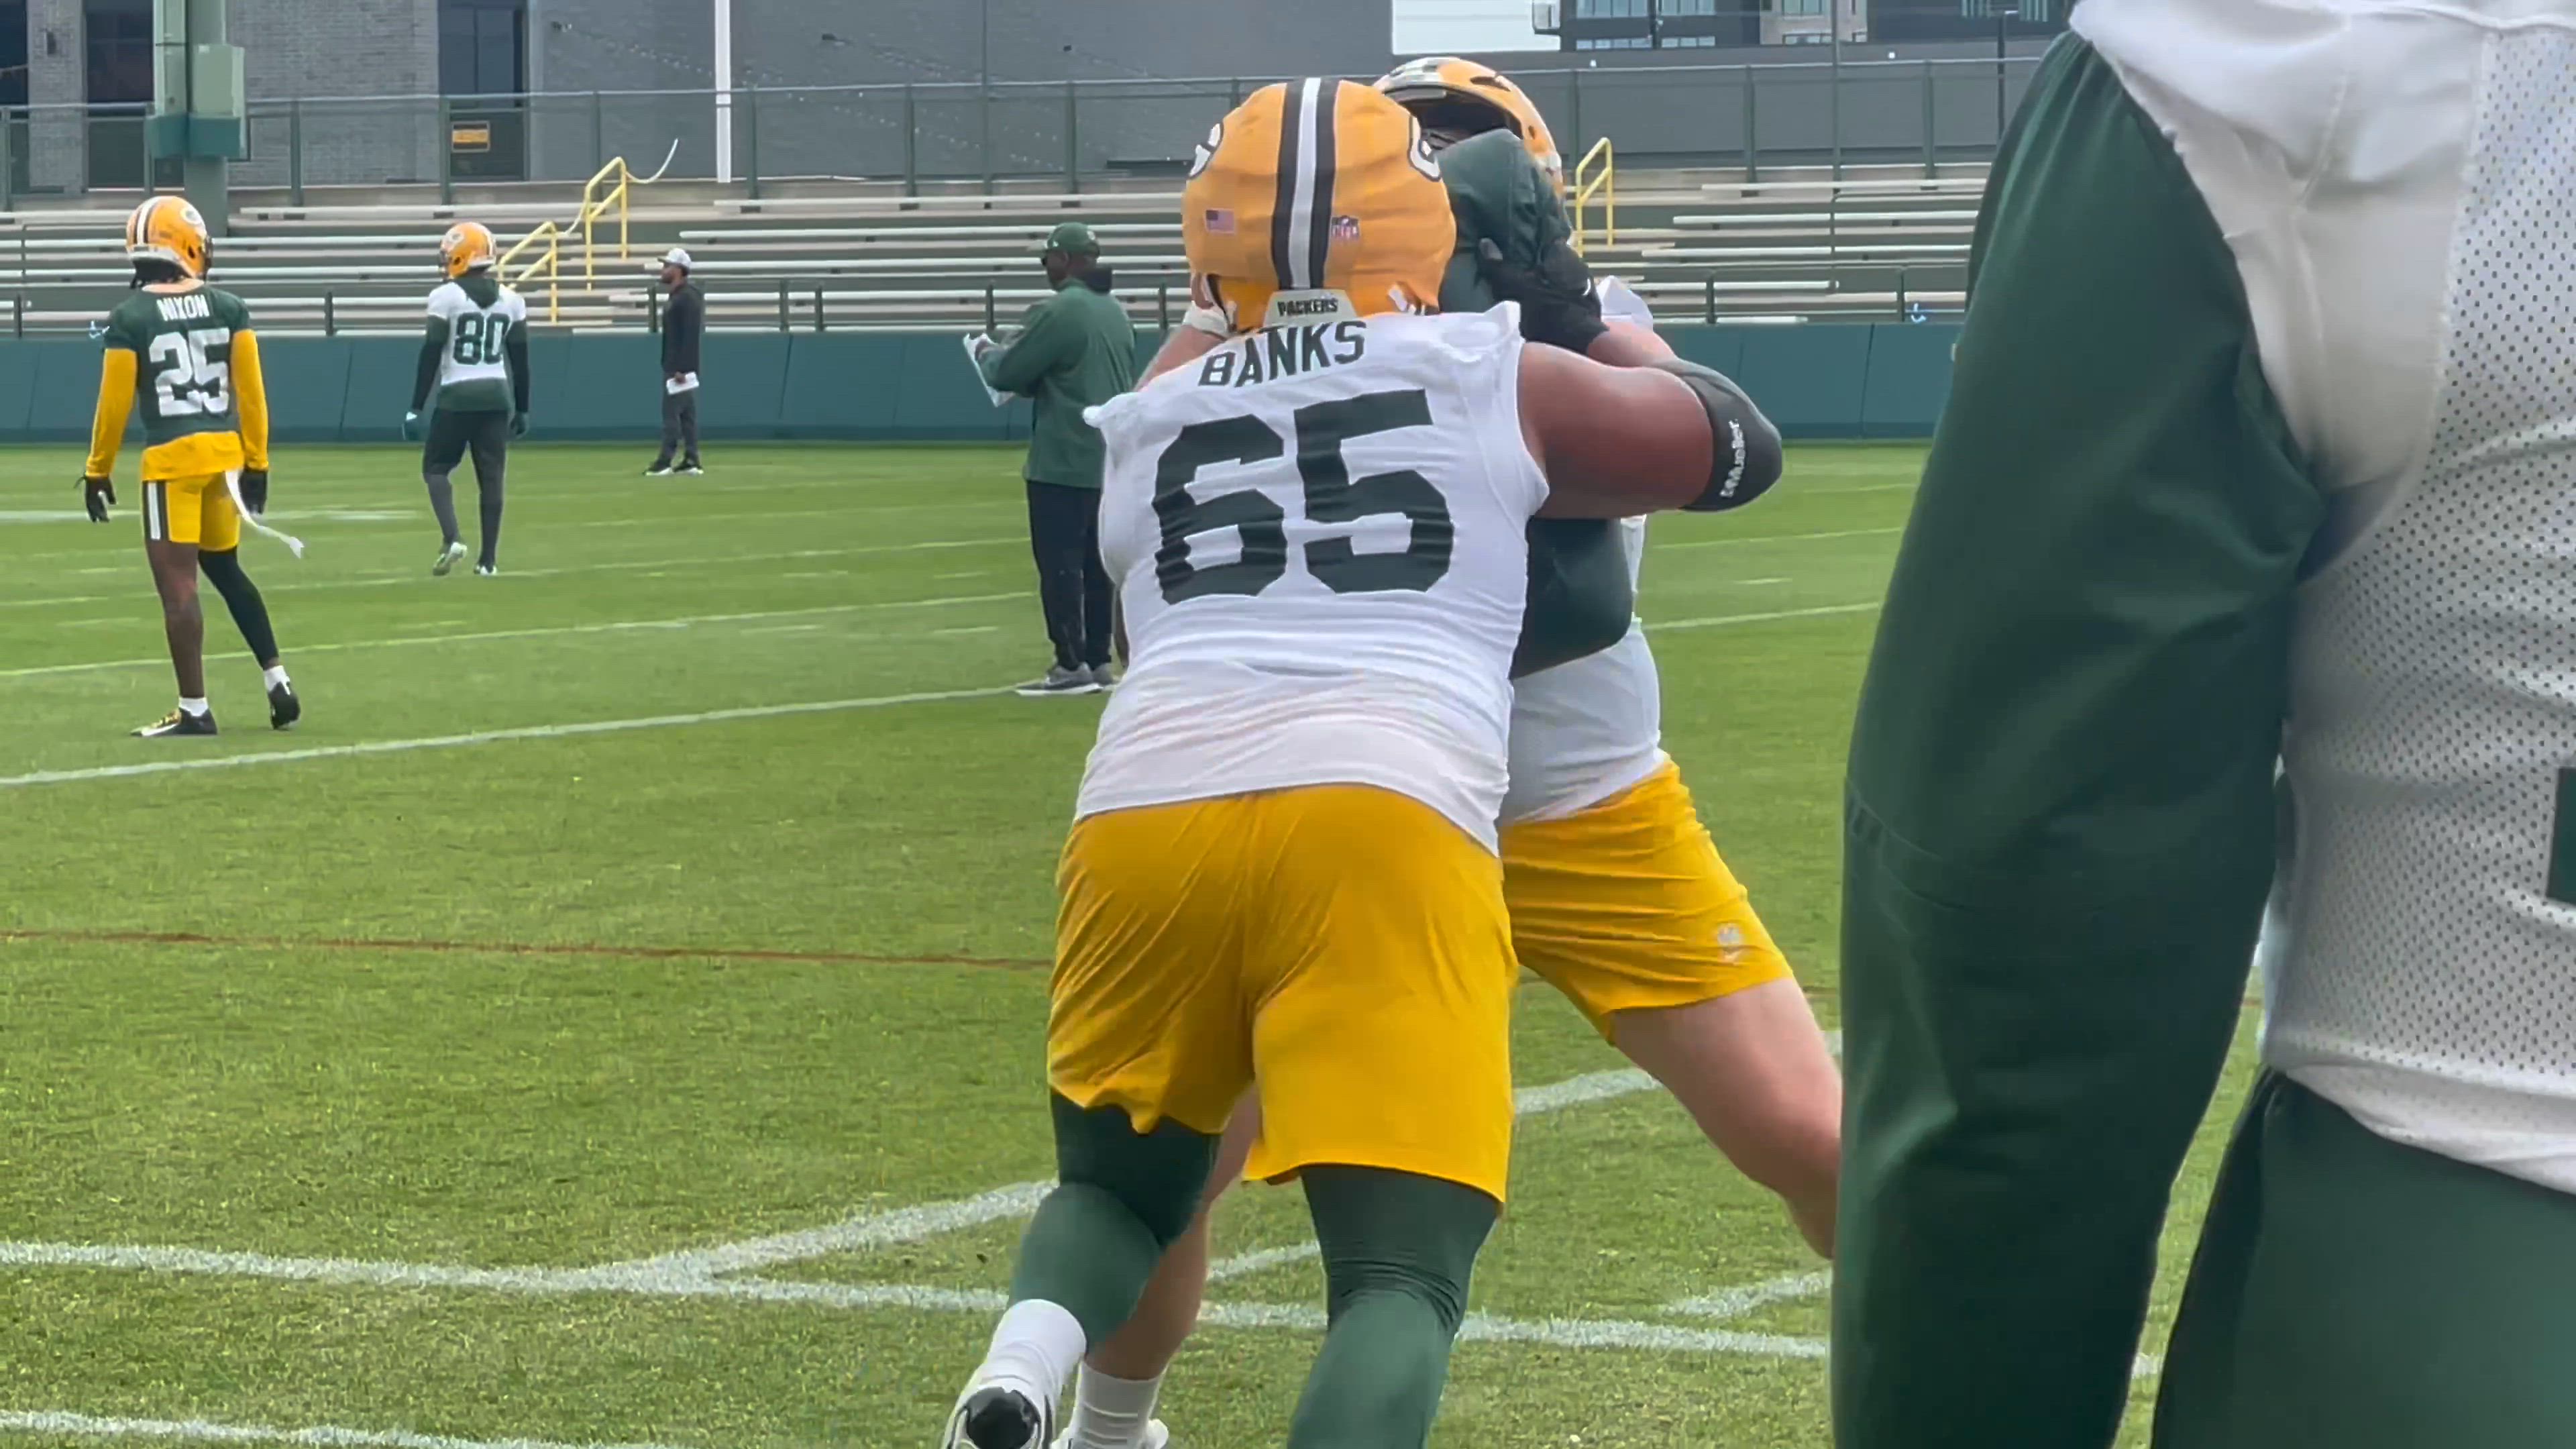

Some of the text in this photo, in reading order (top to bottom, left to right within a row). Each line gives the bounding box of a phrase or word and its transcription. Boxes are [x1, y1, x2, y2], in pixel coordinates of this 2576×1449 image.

[156, 294, 210, 321] NIXON
[1277, 298, 1338, 317] PACKERS
[453, 312, 510, 365] 80
[1198, 321, 1366, 388] BANKS
[149, 327, 230, 417] 25
[1151, 389, 1454, 605] 65
